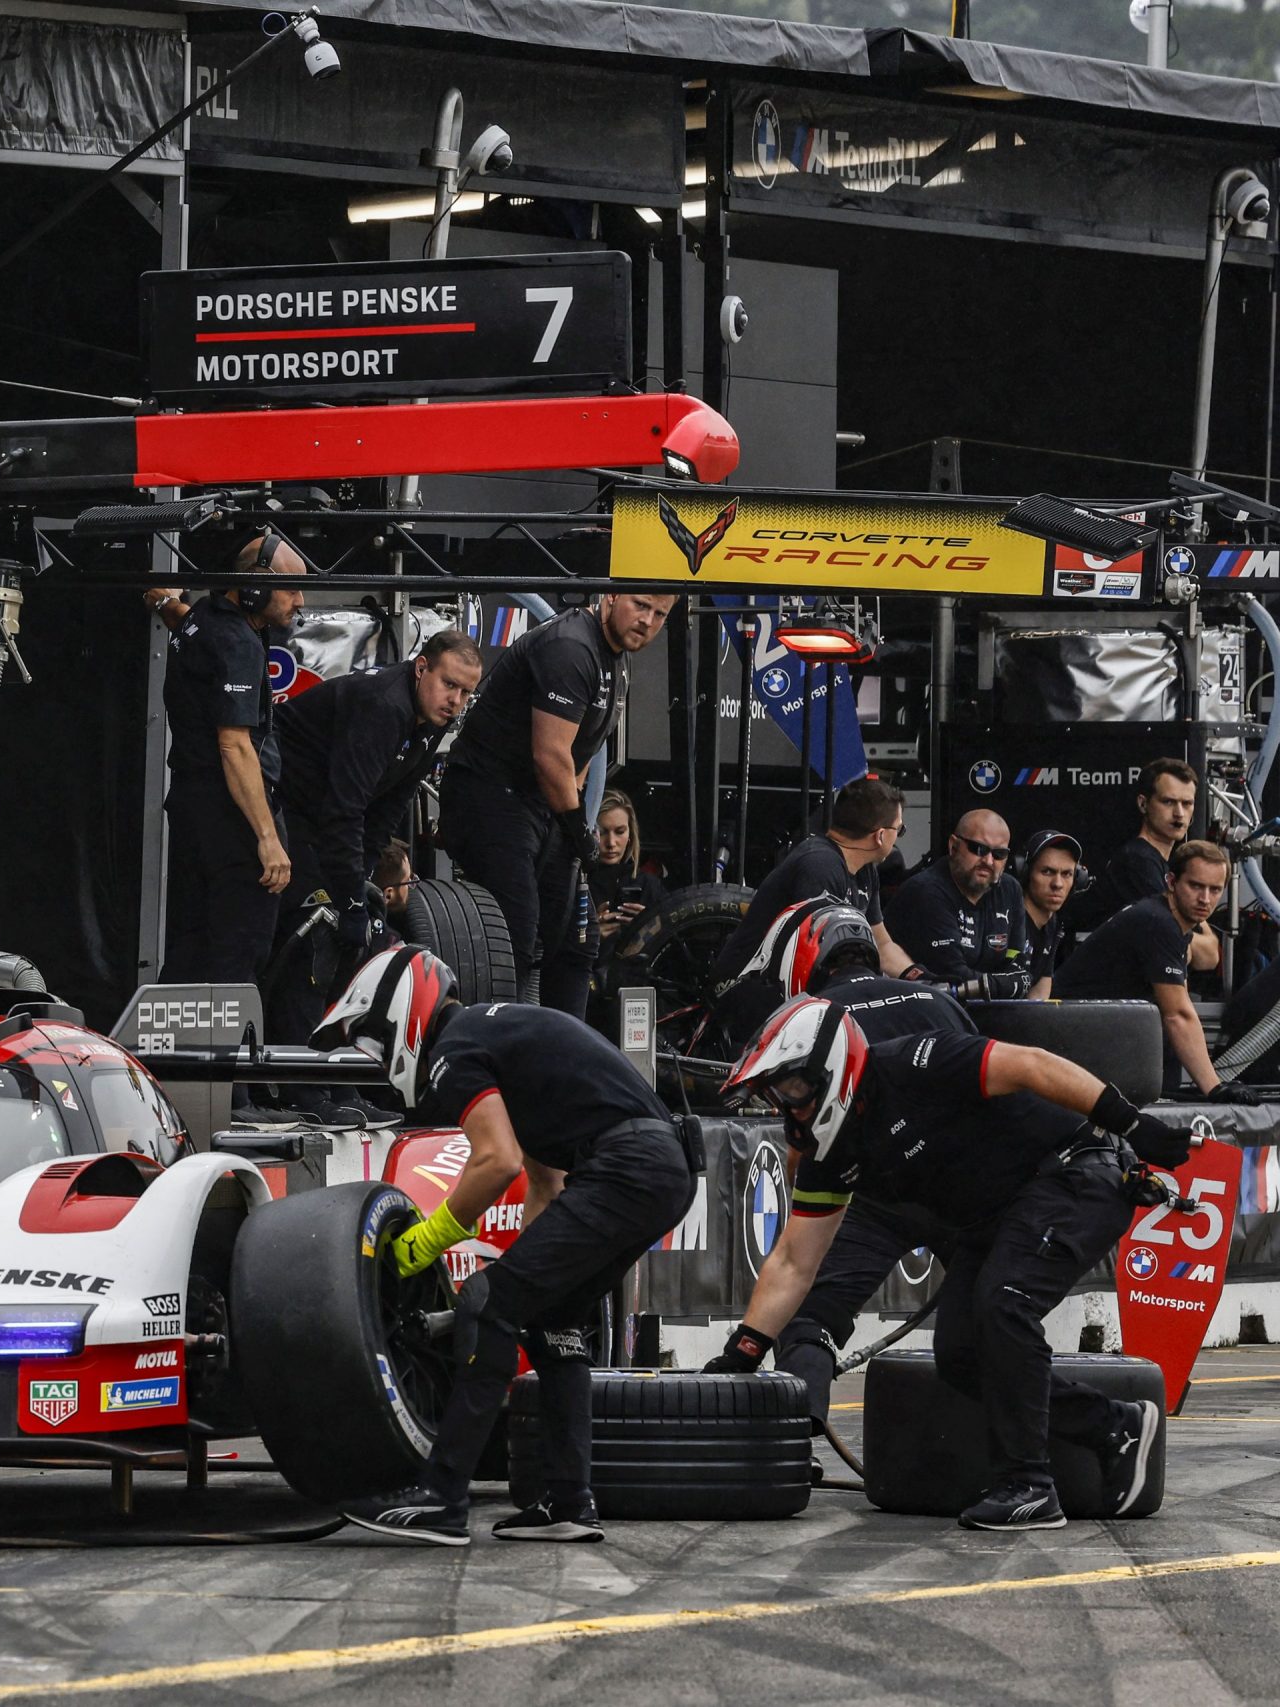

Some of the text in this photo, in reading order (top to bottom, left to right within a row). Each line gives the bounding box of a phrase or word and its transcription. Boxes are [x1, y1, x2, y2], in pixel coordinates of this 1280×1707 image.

[835, 131, 883, 182] Team
[196, 285, 458, 322] PORSCHE PENSKE
[525, 286, 574, 363] 7
[196, 348, 399, 382] MOTORSPORT
[750, 528, 973, 548] CORVETTE
[723, 546, 991, 572] RACING
[1067, 767, 1121, 785] Team
[138, 1000, 240, 1030] PORSCHE
[138, 1032, 175, 1055] 963
[903, 1139, 926, 1160] Ansys
[1130, 1172, 1227, 1251] 25
[144, 1295, 178, 1315] BOSS
[1129, 1290, 1207, 1313] Motorsport
[142, 1320, 181, 1336] HELLER
[134, 1350, 178, 1369] MOTUL
[34, 1384, 74, 1398] TAG
[124, 1386, 172, 1401] MICHELIN
[33, 1401, 75, 1422] HEUER
